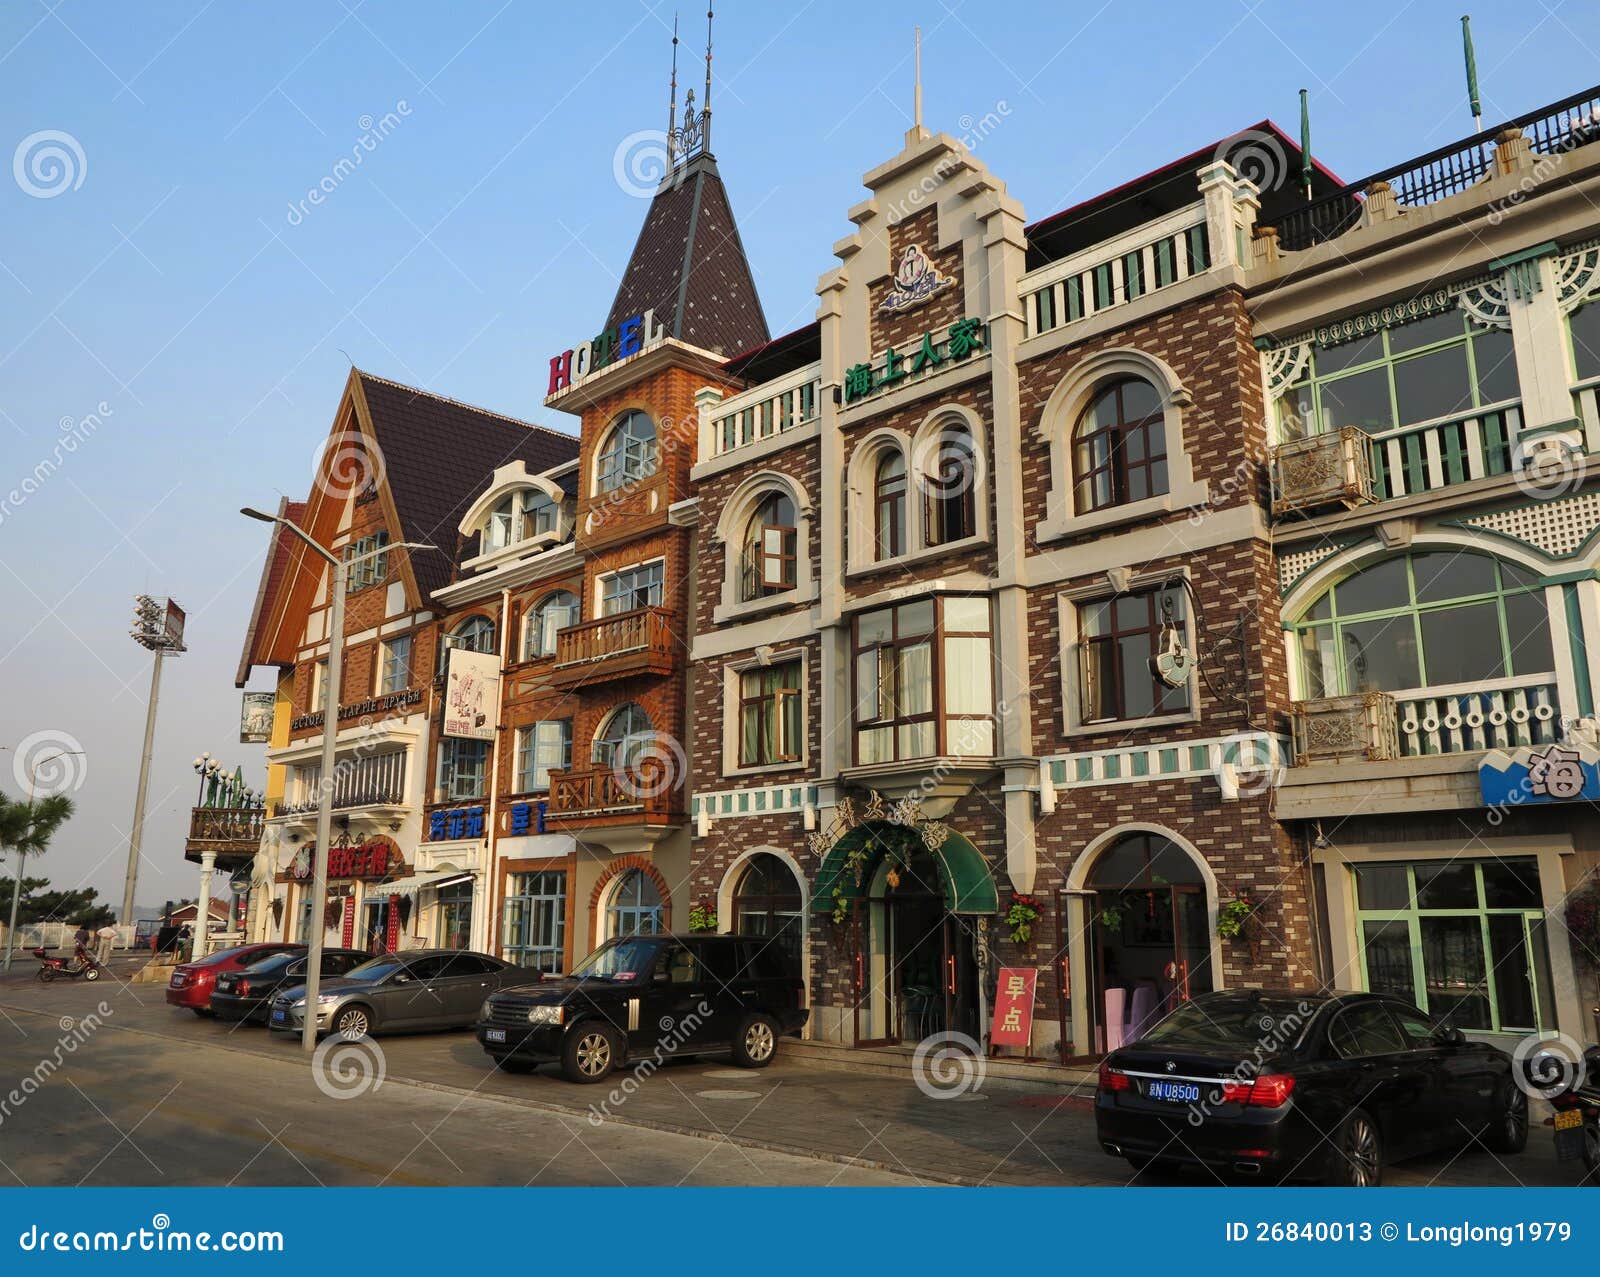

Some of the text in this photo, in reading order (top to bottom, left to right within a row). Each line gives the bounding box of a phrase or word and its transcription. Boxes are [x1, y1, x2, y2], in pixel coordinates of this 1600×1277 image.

[548, 308, 664, 395] HOTEL
[845, 317, 981, 401] 海上人家
[290, 711, 326, 730] РЕСТОРА
[1528, 746, 1585, 798] 海
[1001, 976, 1026, 1033] 早点
